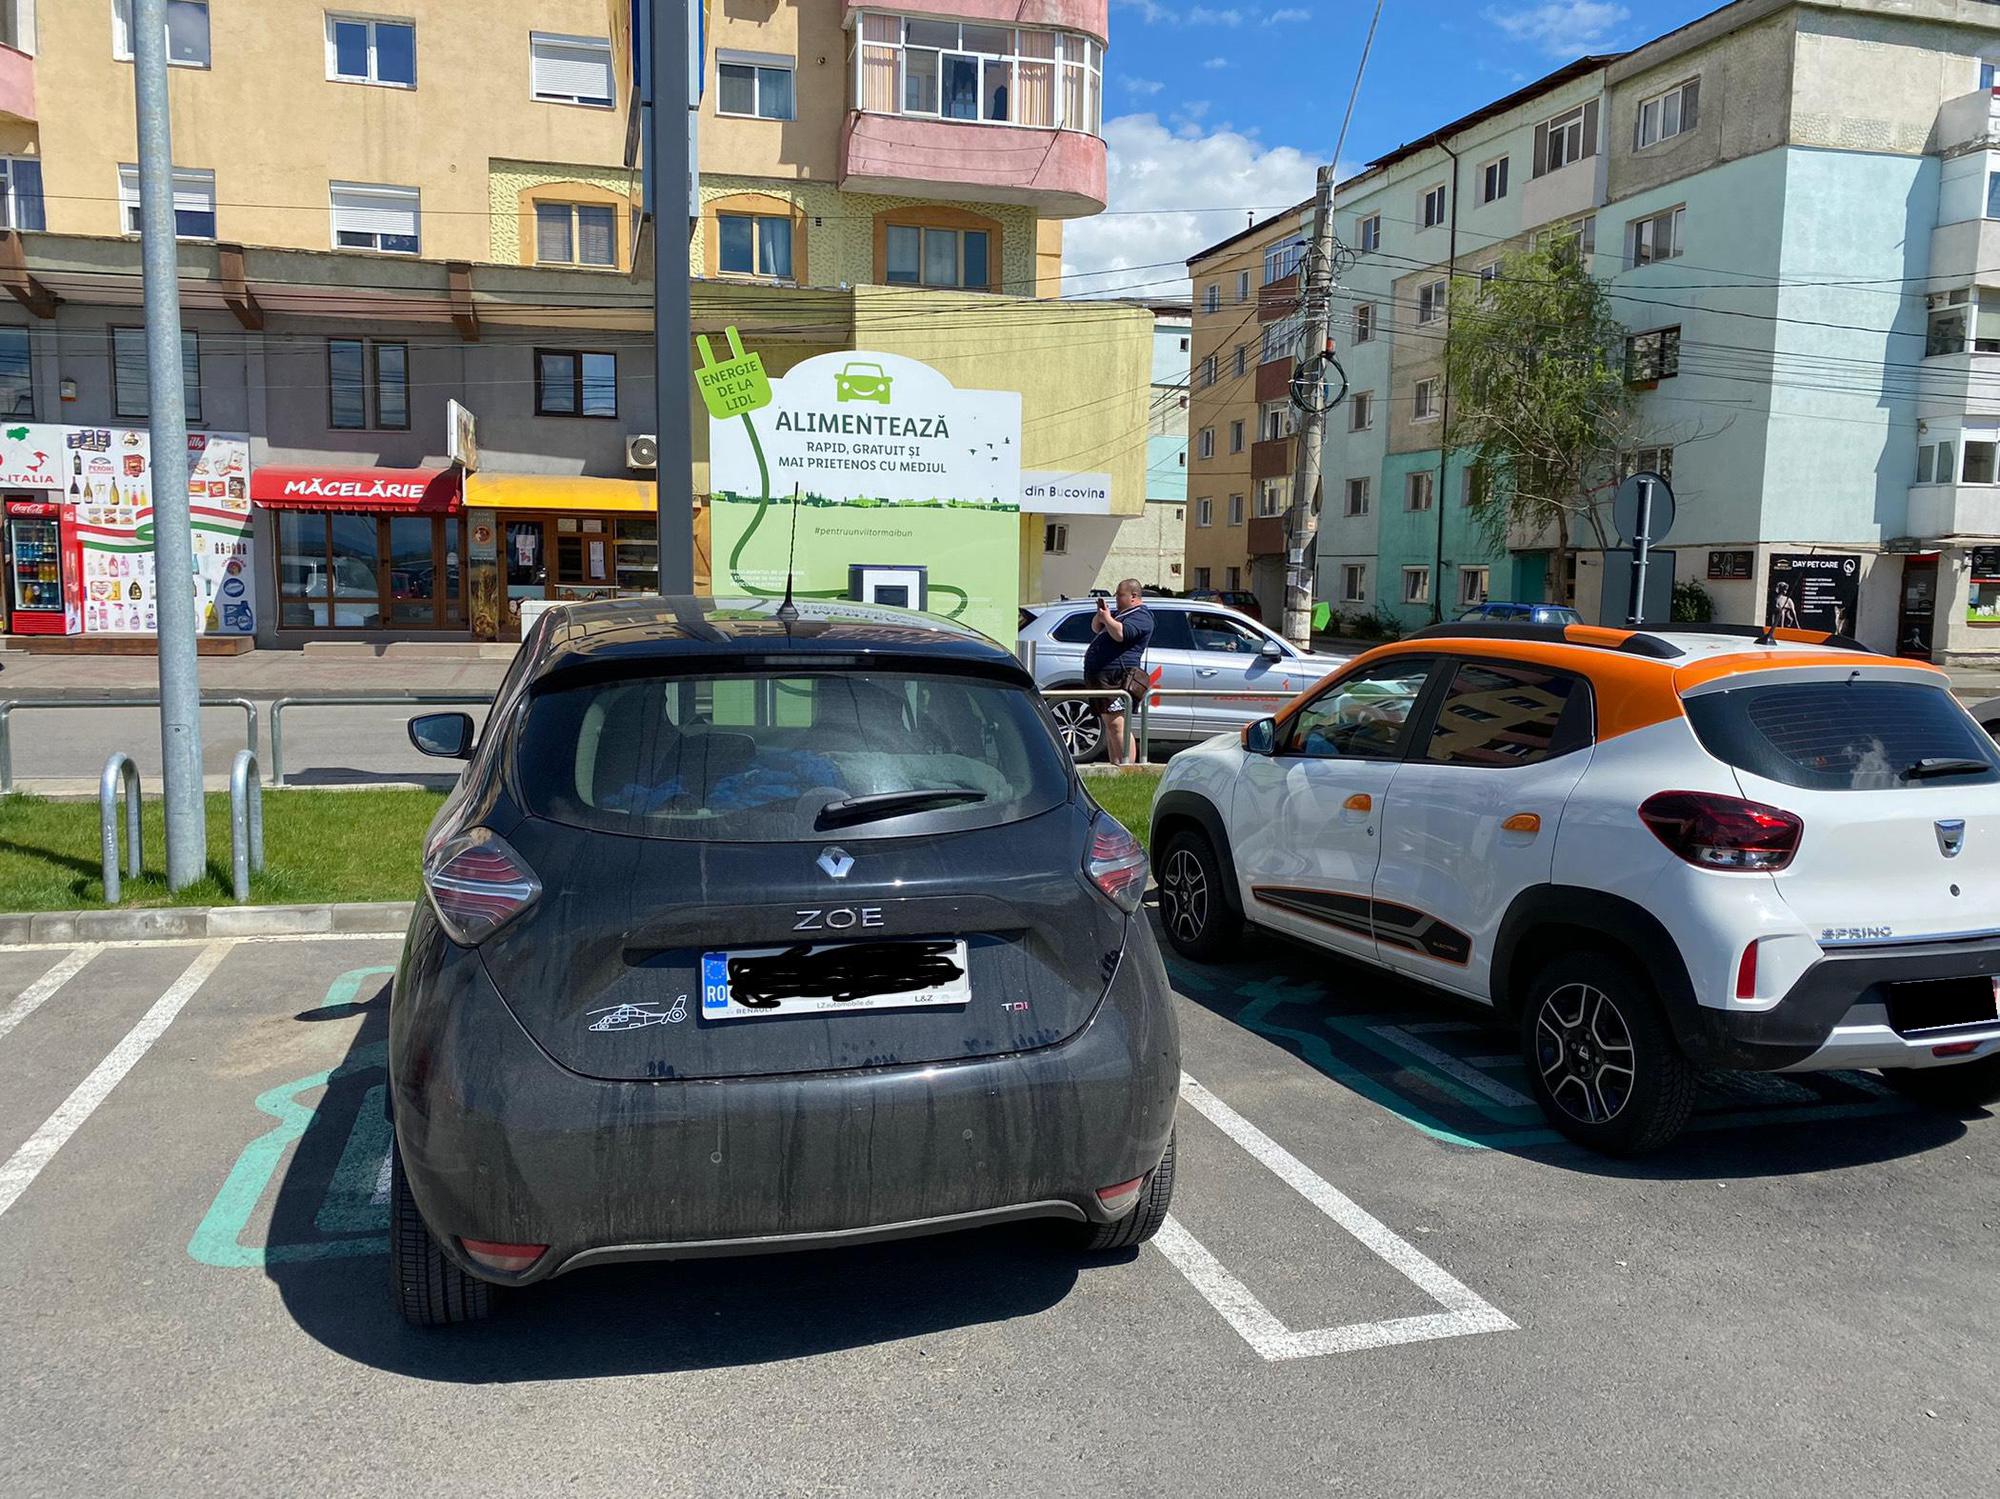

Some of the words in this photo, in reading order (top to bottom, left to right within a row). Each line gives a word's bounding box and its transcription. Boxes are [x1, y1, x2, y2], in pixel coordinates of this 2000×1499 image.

[702, 361, 758, 386] ENERGIE
[717, 383, 736, 397] DE
[737, 378, 754, 391] LA
[726, 394, 756, 411] LIDL
[775, 411, 949, 438] ALIMENTEAZĂ
[806, 441, 850, 455] RAPID,
[852, 443, 906, 456] GRATUIT
[778, 456, 804, 468] MAI
[807, 457, 877, 471] PRIETENOS
[879, 461, 897, 472] CU
[899, 462, 947, 473] MEDIUL
[8, 474, 54, 483] ITALIA
[284, 478, 425, 498] MĂCELĂRIE
[1024, 485, 1045, 497] din
[1049, 486, 1105, 499] Bucovina
[1792, 560, 1806, 568] DAY
[1806, 561, 1820, 569] PET
[1820, 561, 1839, 569] CARE
[792, 907, 885, 930] ZOE
[707, 985, 726, 1002] RO
[1000, 1001, 1028, 1011] TDI
